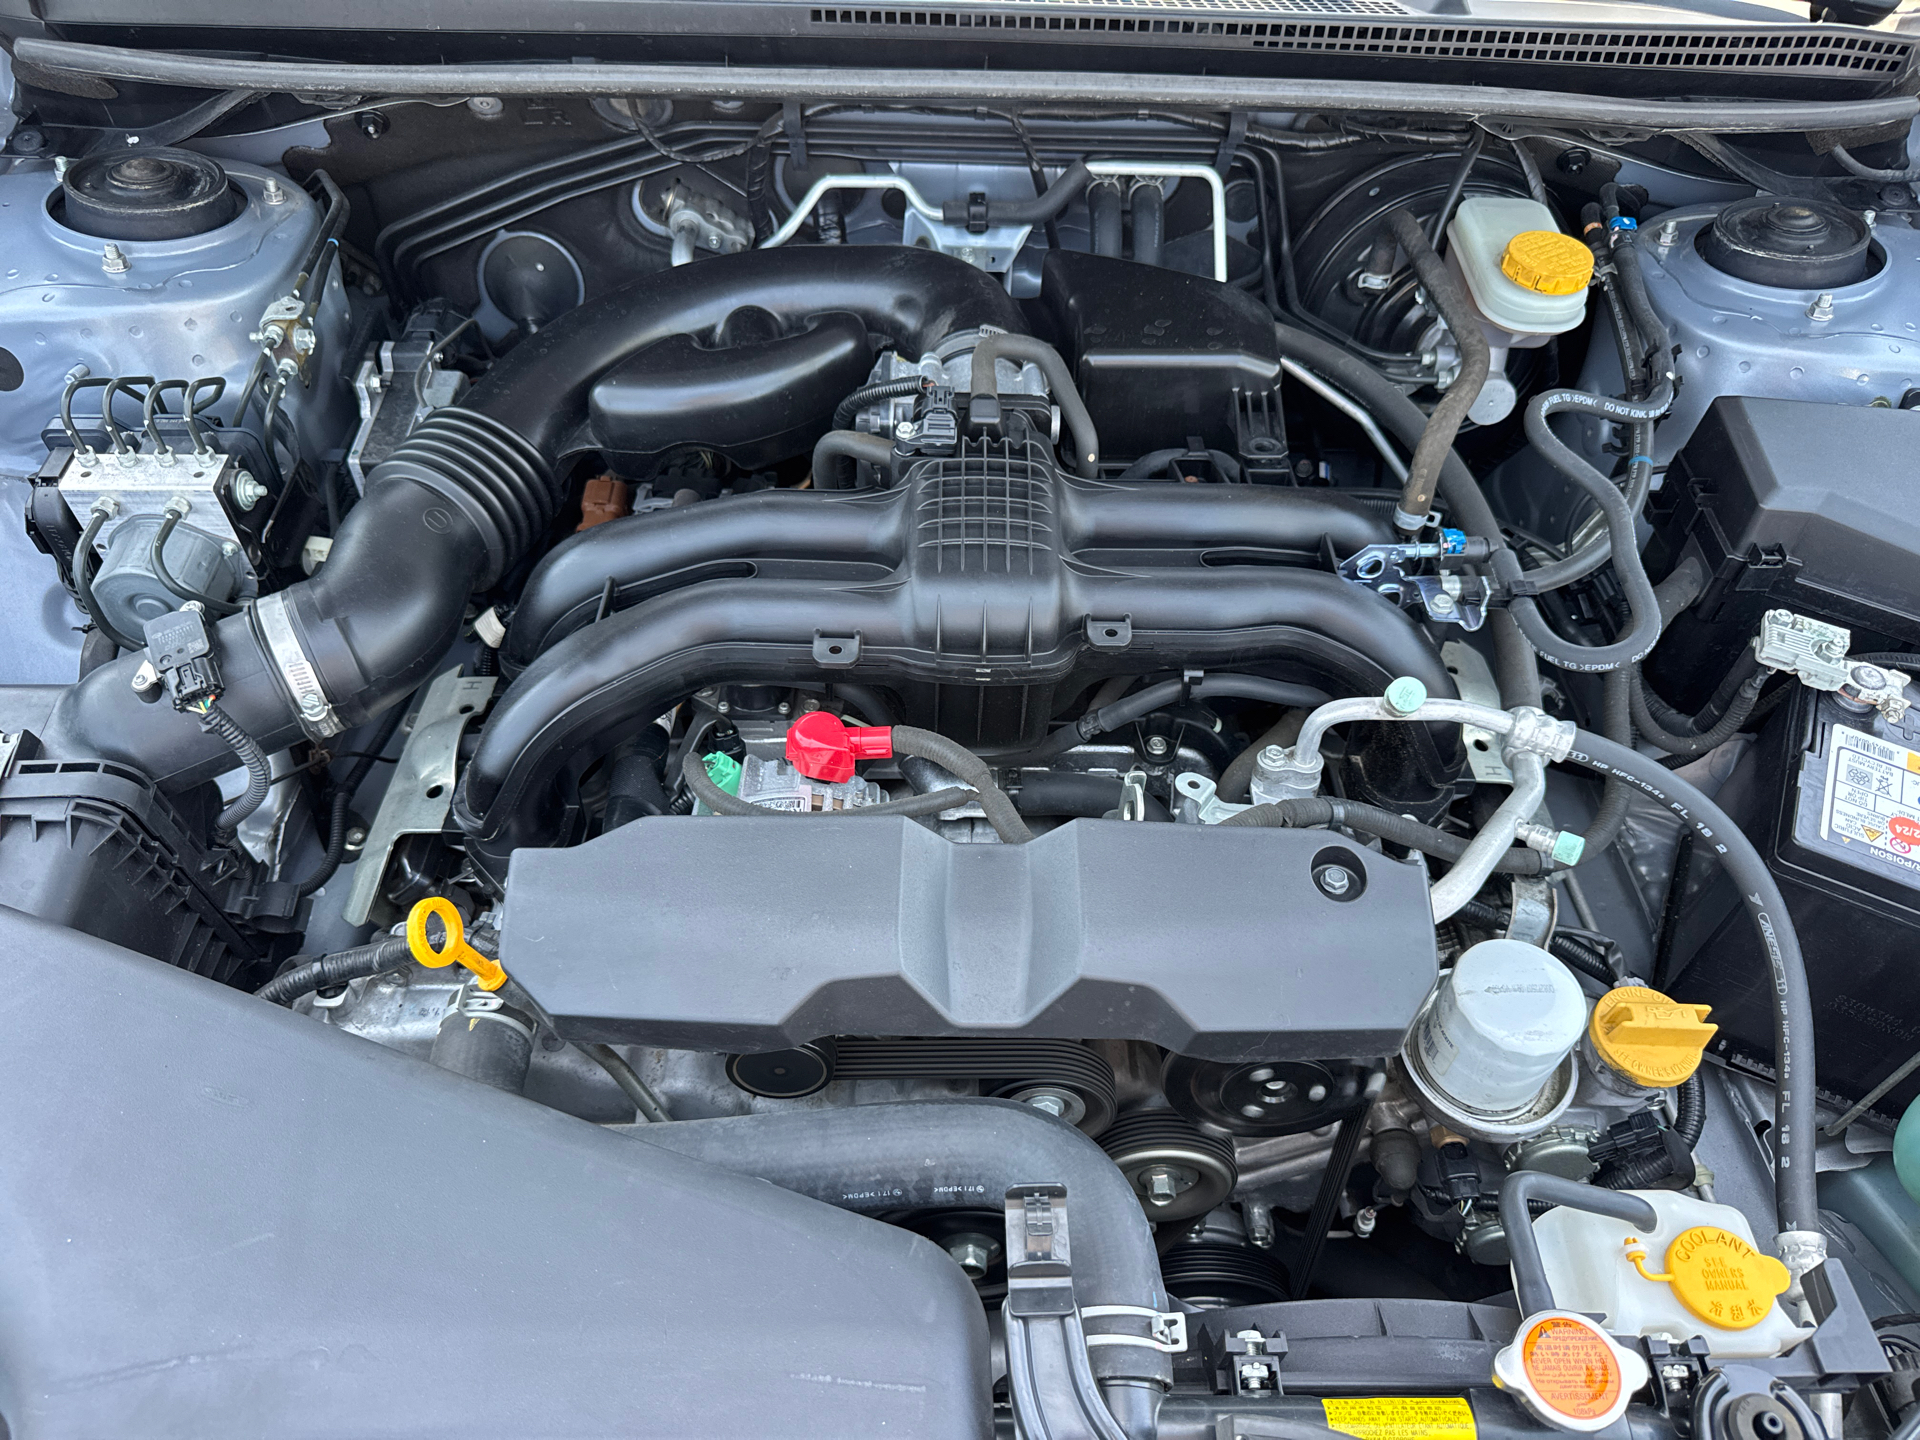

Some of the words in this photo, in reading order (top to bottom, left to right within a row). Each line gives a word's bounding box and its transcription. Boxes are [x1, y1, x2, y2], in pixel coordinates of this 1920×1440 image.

[1548, 394, 1562, 405] FUEL
[1561, 393, 1571, 402] TG
[1604, 402, 1615, 412] DO
[1615, 405, 1629, 416] NOT
[1540, 651, 1560, 666] FUEL
[1562, 660, 1577, 670] TG
[1631, 652, 1644, 663] DO
[1848, 757, 1865, 766] MUST
[1867, 764, 1893, 776] BATTERY
[1592, 760, 1609, 770] HP
[1611, 768, 1665, 799] HFC-134a
[1670, 802, 1689, 819] FL
[1715, 843, 1728, 854] 2
[1844, 795, 1857, 803] NOT
[1845, 822, 1860, 832] ACID
[1605, 988, 1648, 1008] ENGINE
[1779, 1000, 1787, 1015] HP
[1782, 1020, 1790, 1079] HFC-134a
[1614, 1049, 1631, 1064] SEE
[1672, 1052, 1699, 1075] MANUAL
[1782, 1090, 1790, 1113] FL
[1781, 1156, 1790, 1168] 2
[1675, 1230, 1755, 1262] COOLANT
[1704, 1257, 1727, 1267] SEE
[1705, 1280, 1749, 1291] MANUAL
